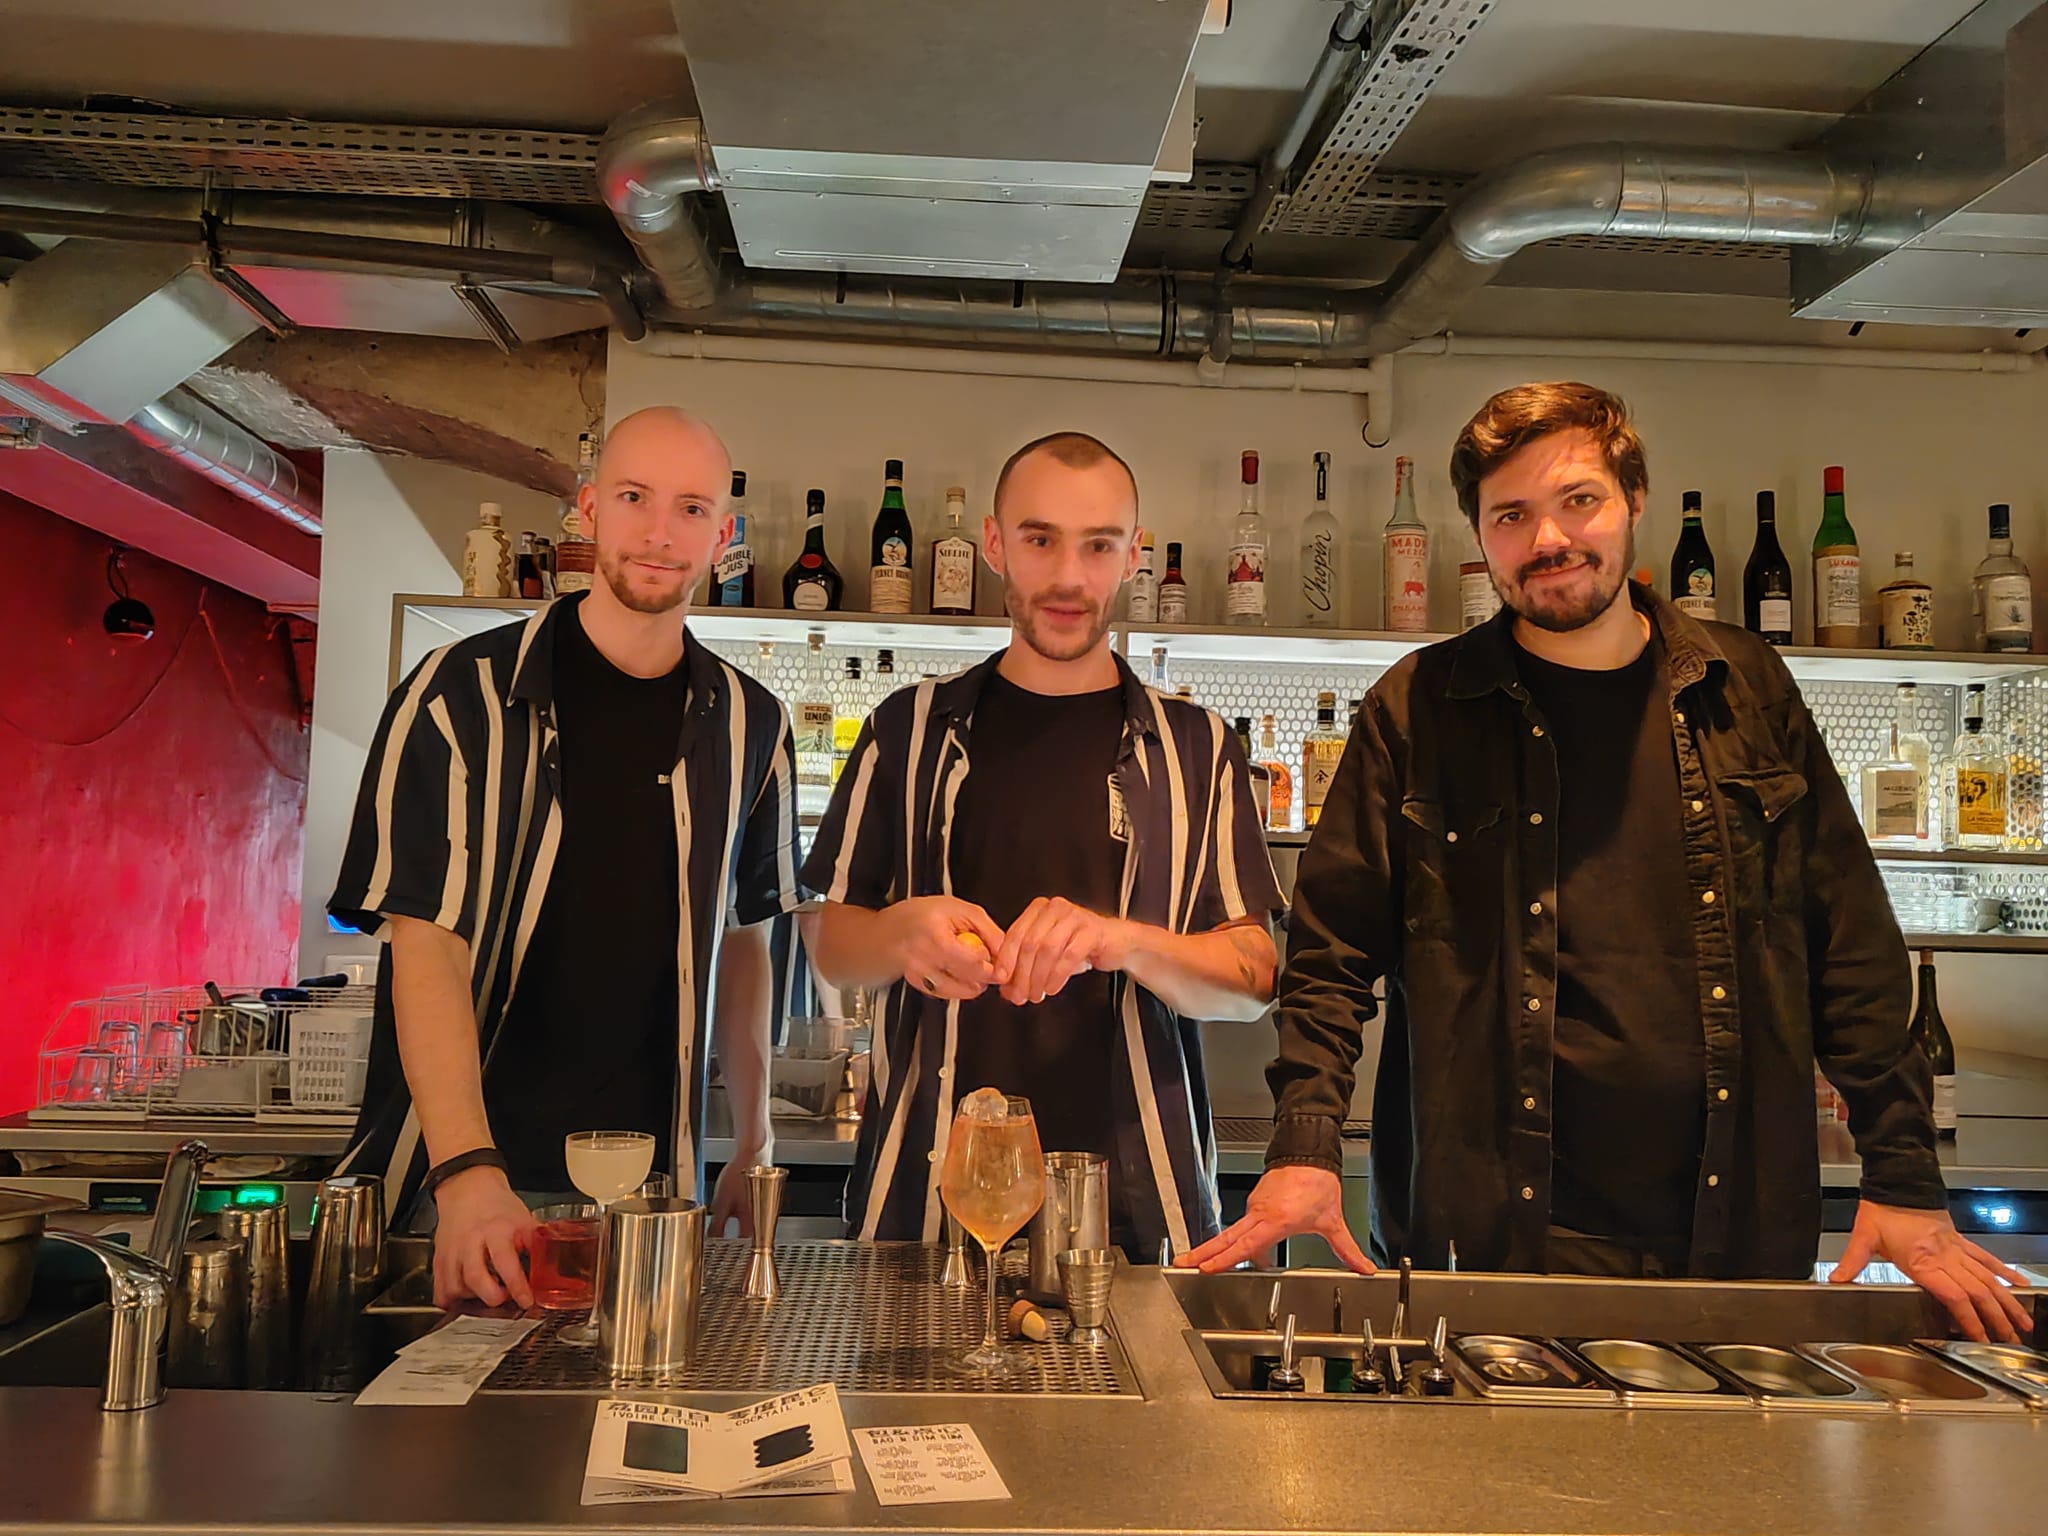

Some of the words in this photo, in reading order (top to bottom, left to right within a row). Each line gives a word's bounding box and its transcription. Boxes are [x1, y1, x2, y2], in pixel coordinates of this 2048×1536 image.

[724, 560, 745, 575] JUS
[1303, 529, 1336, 612] Chopin
[612, 1411, 655, 1421] IVOIRE
[662, 1416, 704, 1429] LITCHI
[735, 1405, 791, 1427] COCKTAIL
[872, 1437, 894, 1445] BAO
